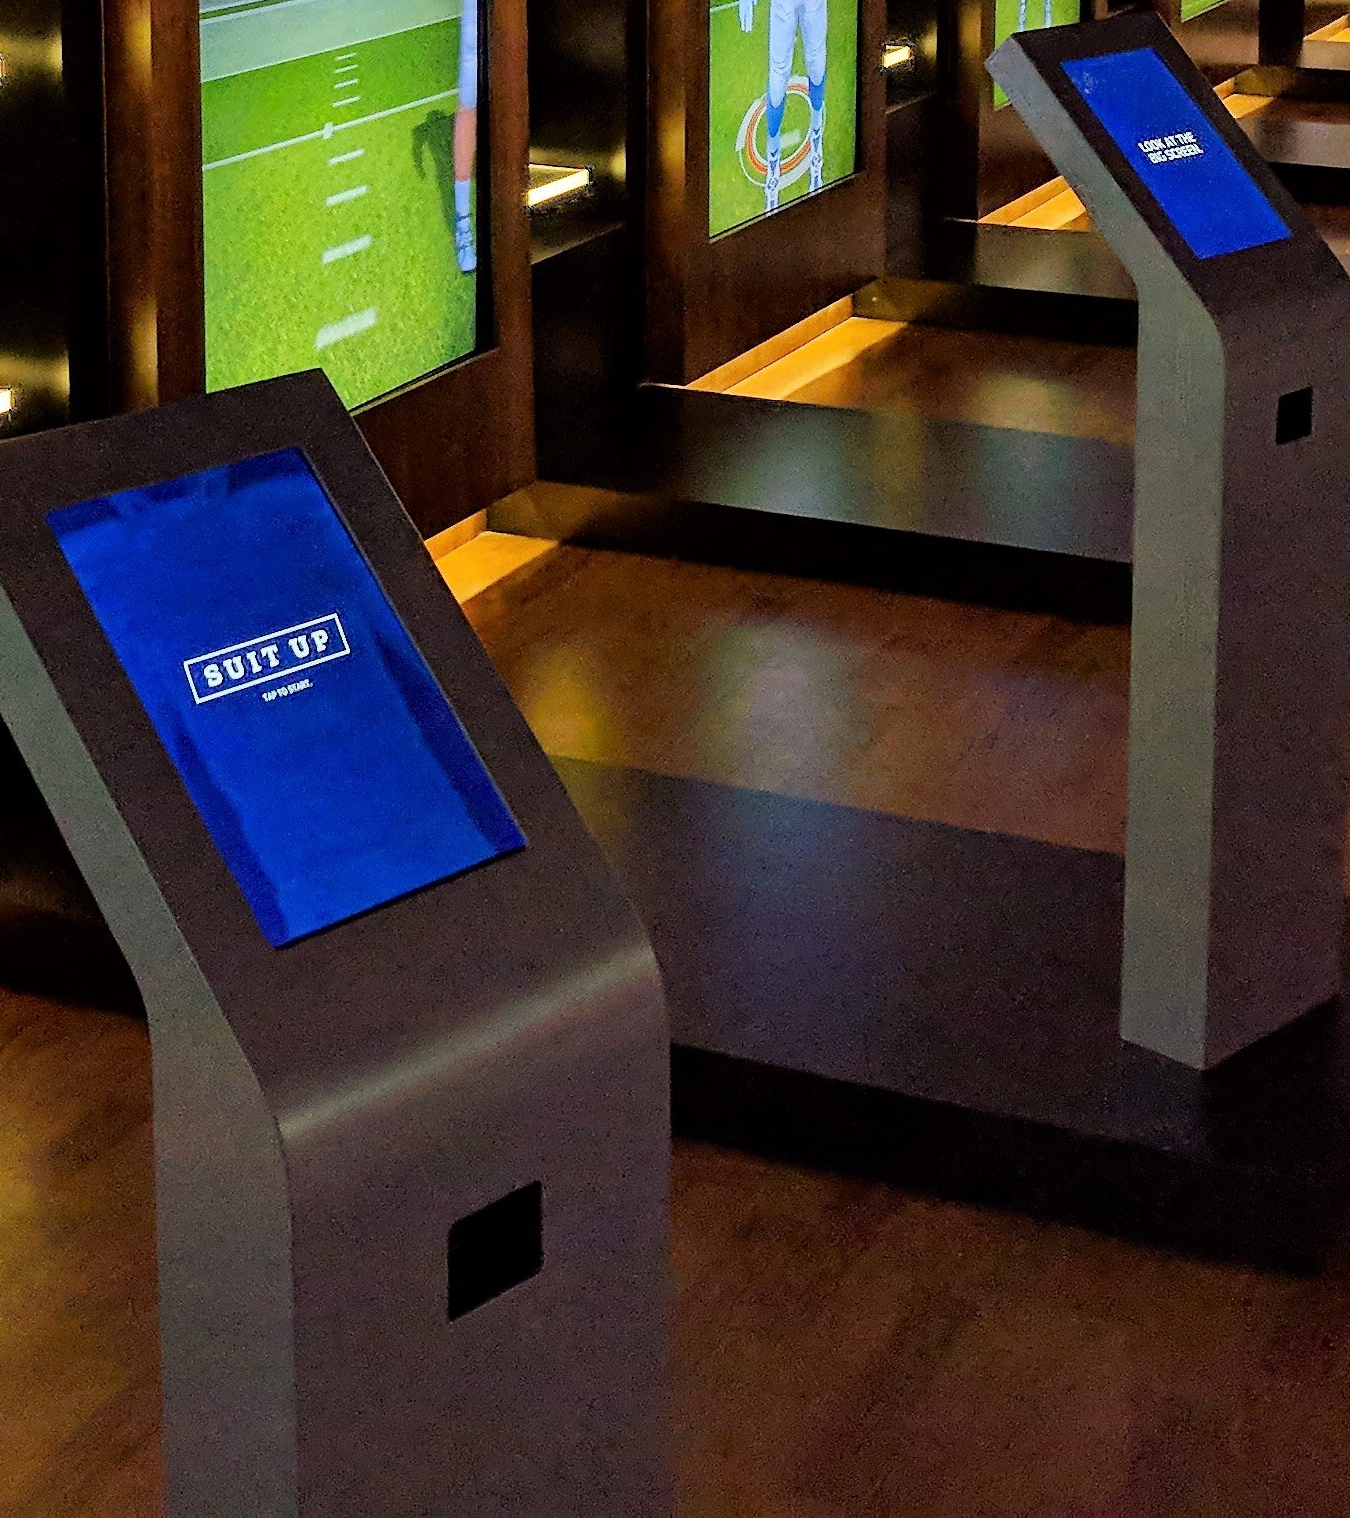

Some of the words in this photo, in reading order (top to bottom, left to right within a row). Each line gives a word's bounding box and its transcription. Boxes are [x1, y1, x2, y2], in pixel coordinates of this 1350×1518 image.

[1137, 137, 1167, 153] LOOK
[1163, 135, 1178, 148] AT
[1174, 131, 1197, 145] THE
[1147, 150, 1168, 164] BIG
[1163, 143, 1204, 161] SCREEN
[203, 643, 280, 688] SUIT
[288, 629, 329, 659] UP
